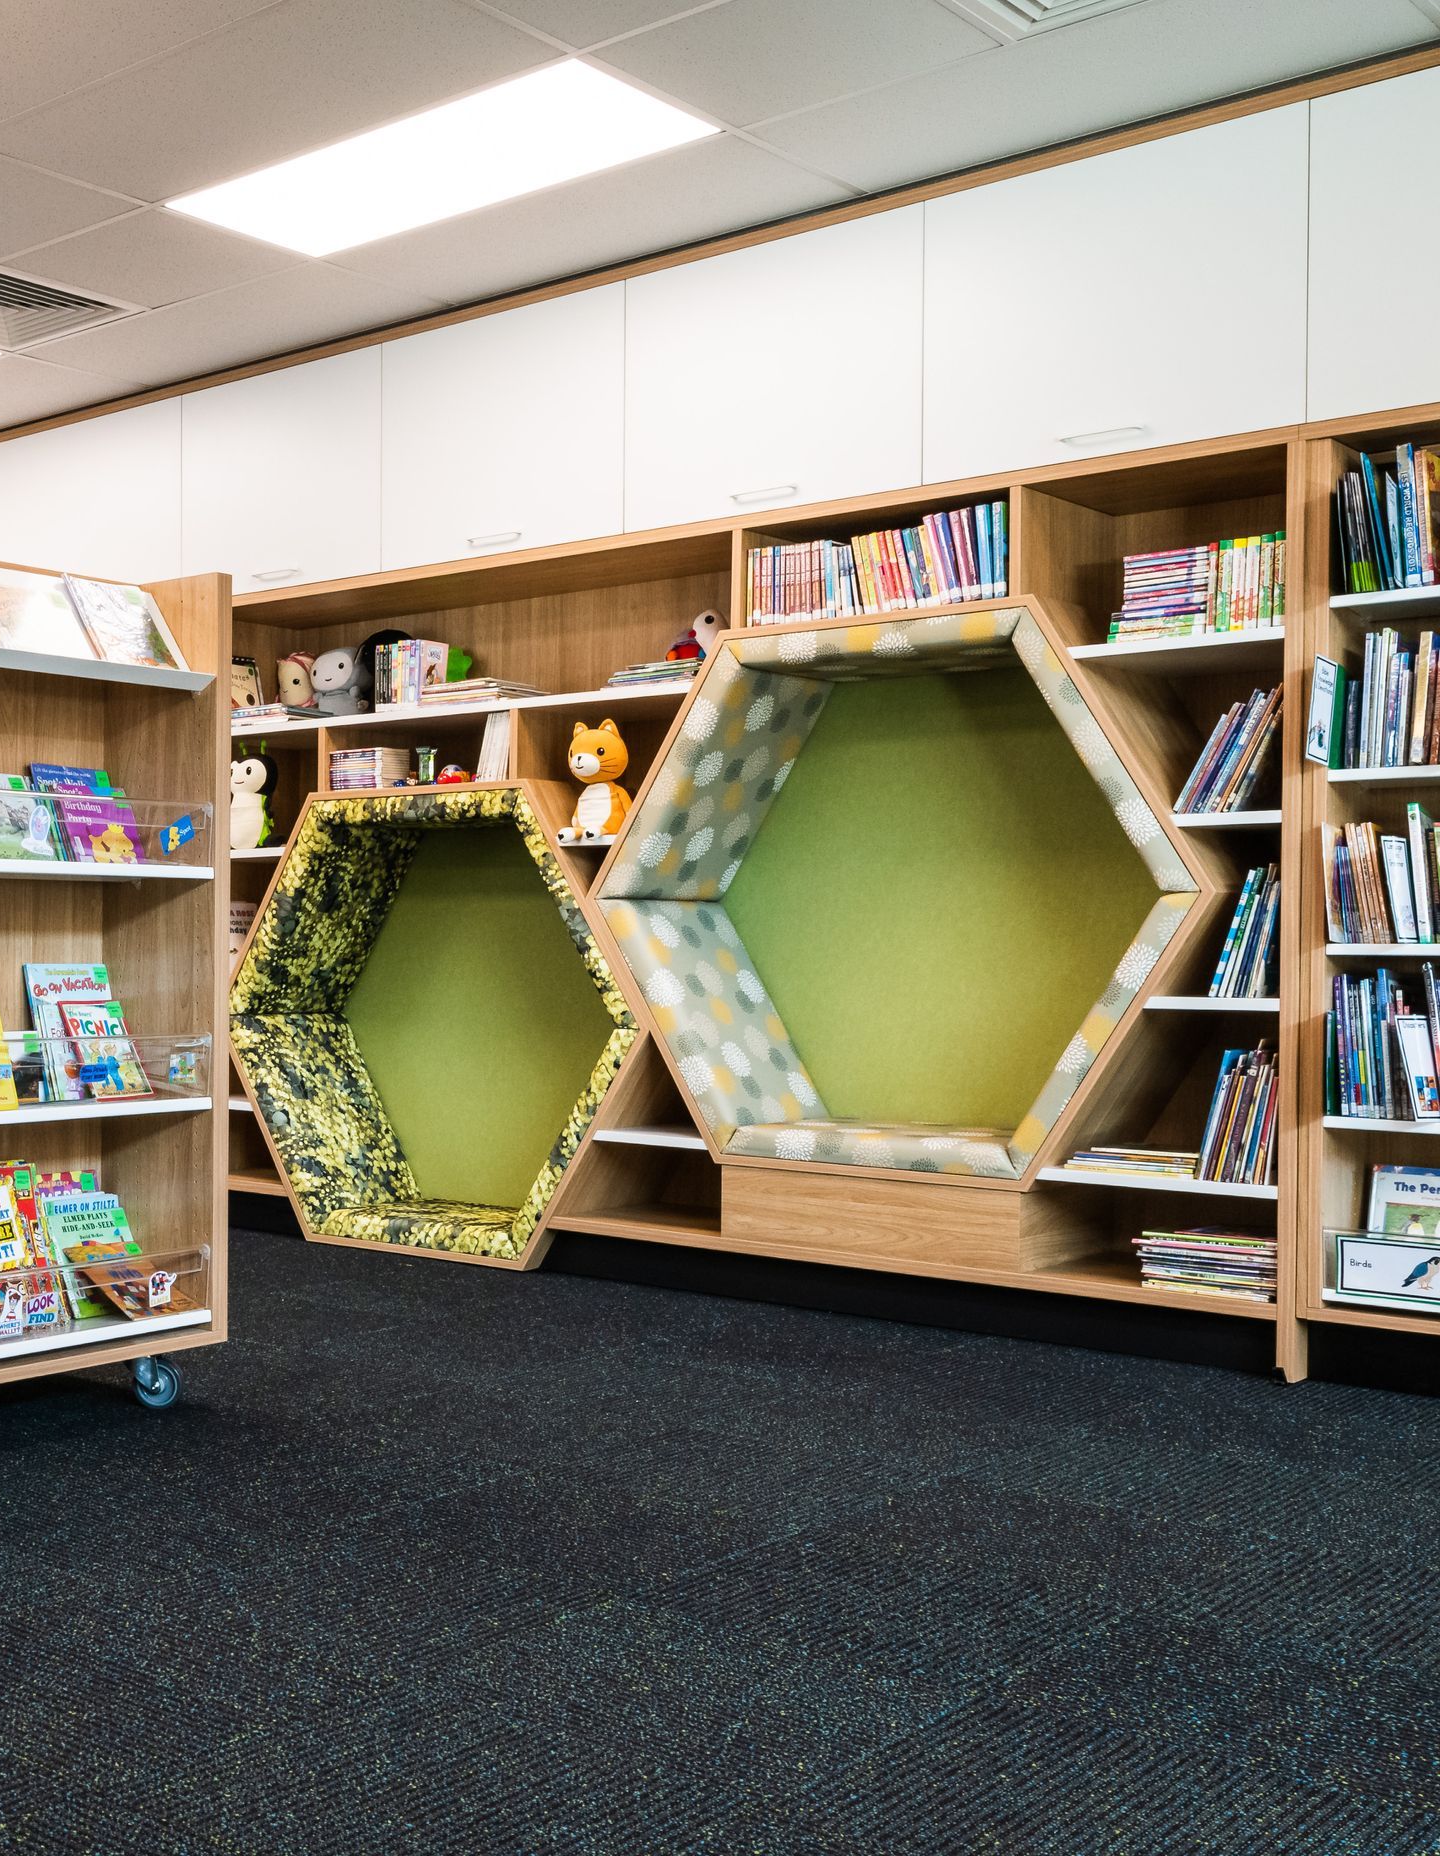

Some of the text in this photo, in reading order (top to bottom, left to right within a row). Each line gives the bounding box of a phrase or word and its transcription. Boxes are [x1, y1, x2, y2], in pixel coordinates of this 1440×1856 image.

[1403, 487, 1412, 518] WORLD
[1405, 517, 1415, 553] RECORDS
[63, 800, 102, 814] Birthday
[67, 812, 92, 825] Party
[178, 825, 192, 837] Spot
[62, 977, 106, 992] VACATION
[68, 1017, 119, 1036] PICNIC
[1394, 1181, 1416, 1192] The
[54, 1199, 115, 1214] ELMER ON STILTS
[63, 1212, 108, 1223] ELMER PLAYS
[61, 1220, 115, 1233] HIDE-AND-SEEK
[1349, 1258, 1372, 1269] Birds
[27, 1293, 54, 1314] LOOK
[28, 1312, 55, 1325] FIND
